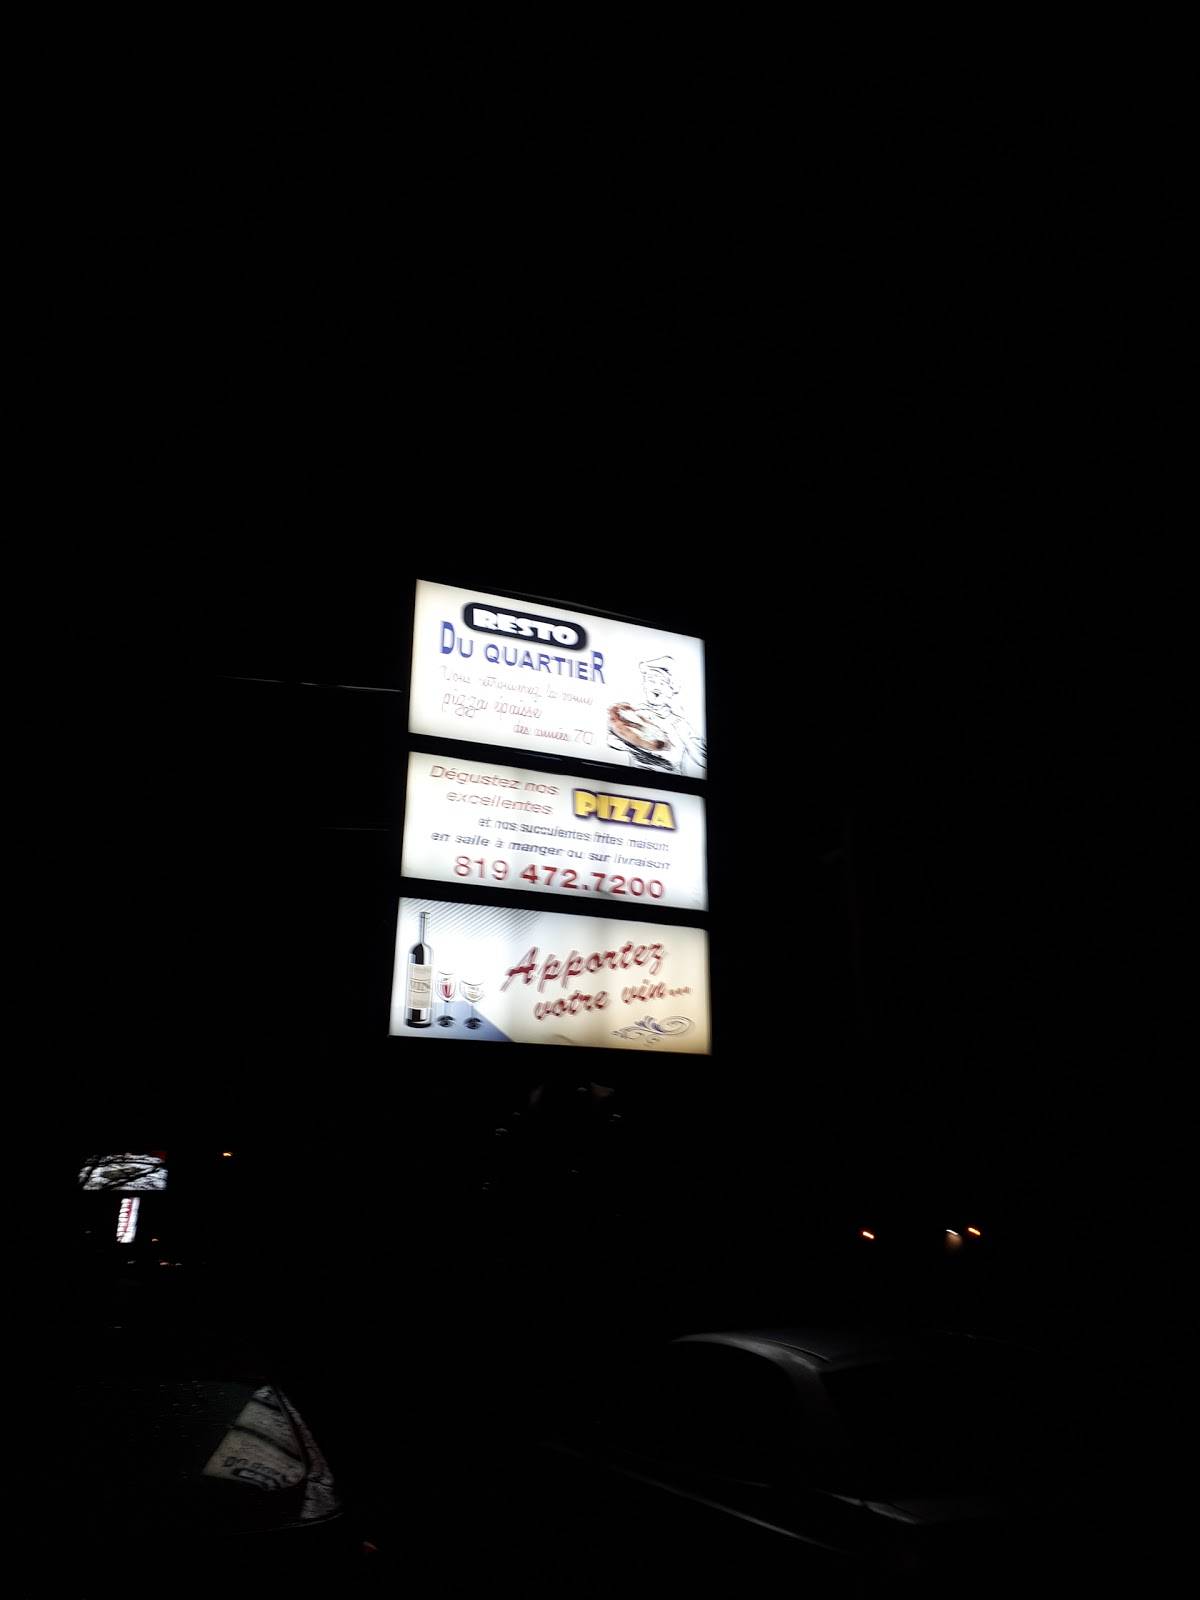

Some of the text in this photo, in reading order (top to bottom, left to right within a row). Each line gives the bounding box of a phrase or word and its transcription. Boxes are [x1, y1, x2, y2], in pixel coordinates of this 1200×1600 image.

[472, 608, 578, 646] RESTO
[442, 688, 488, 719] pizza
[430, 764, 560, 796] Dégustez nos
[446, 790, 554, 816] excellentes
[573, 789, 677, 830] PIZZA
[478, 816, 493, 829] et
[495, 820, 518, 832] nos
[431, 832, 672, 870] en salle à manger ou sur livraison
[453, 855, 665, 899] 819 472.7200
[500, 941, 666, 994] Apportez
[534, 990, 609, 1021] votre
